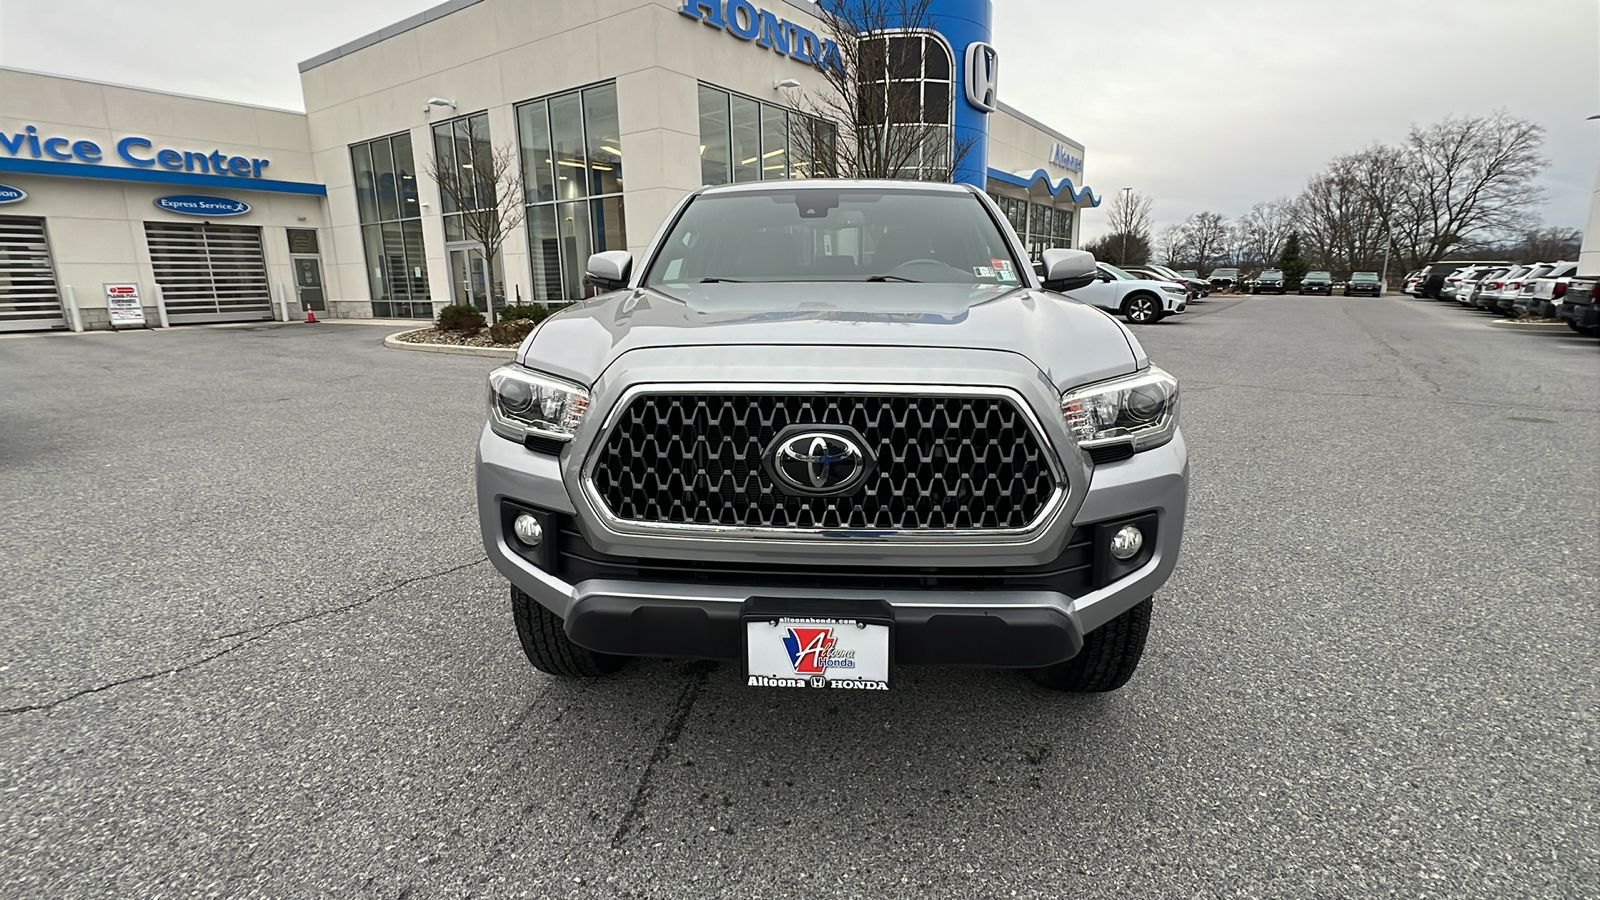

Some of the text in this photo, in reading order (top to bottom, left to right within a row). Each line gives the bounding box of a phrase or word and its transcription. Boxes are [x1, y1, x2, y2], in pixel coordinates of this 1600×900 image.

[679, 0, 848, 78] HONDA
[117, 137, 270, 178] Center
[0, 190, 18, 198] on
[160, 199, 233, 210] Express Service
[779, 617, 857, 625] altoonahonda.com
[796, 632, 855, 668] Altoona
[819, 657, 854, 668] Honda
[748, 675, 805, 688] Altoona
[830, 680, 889, 691] HONDA
